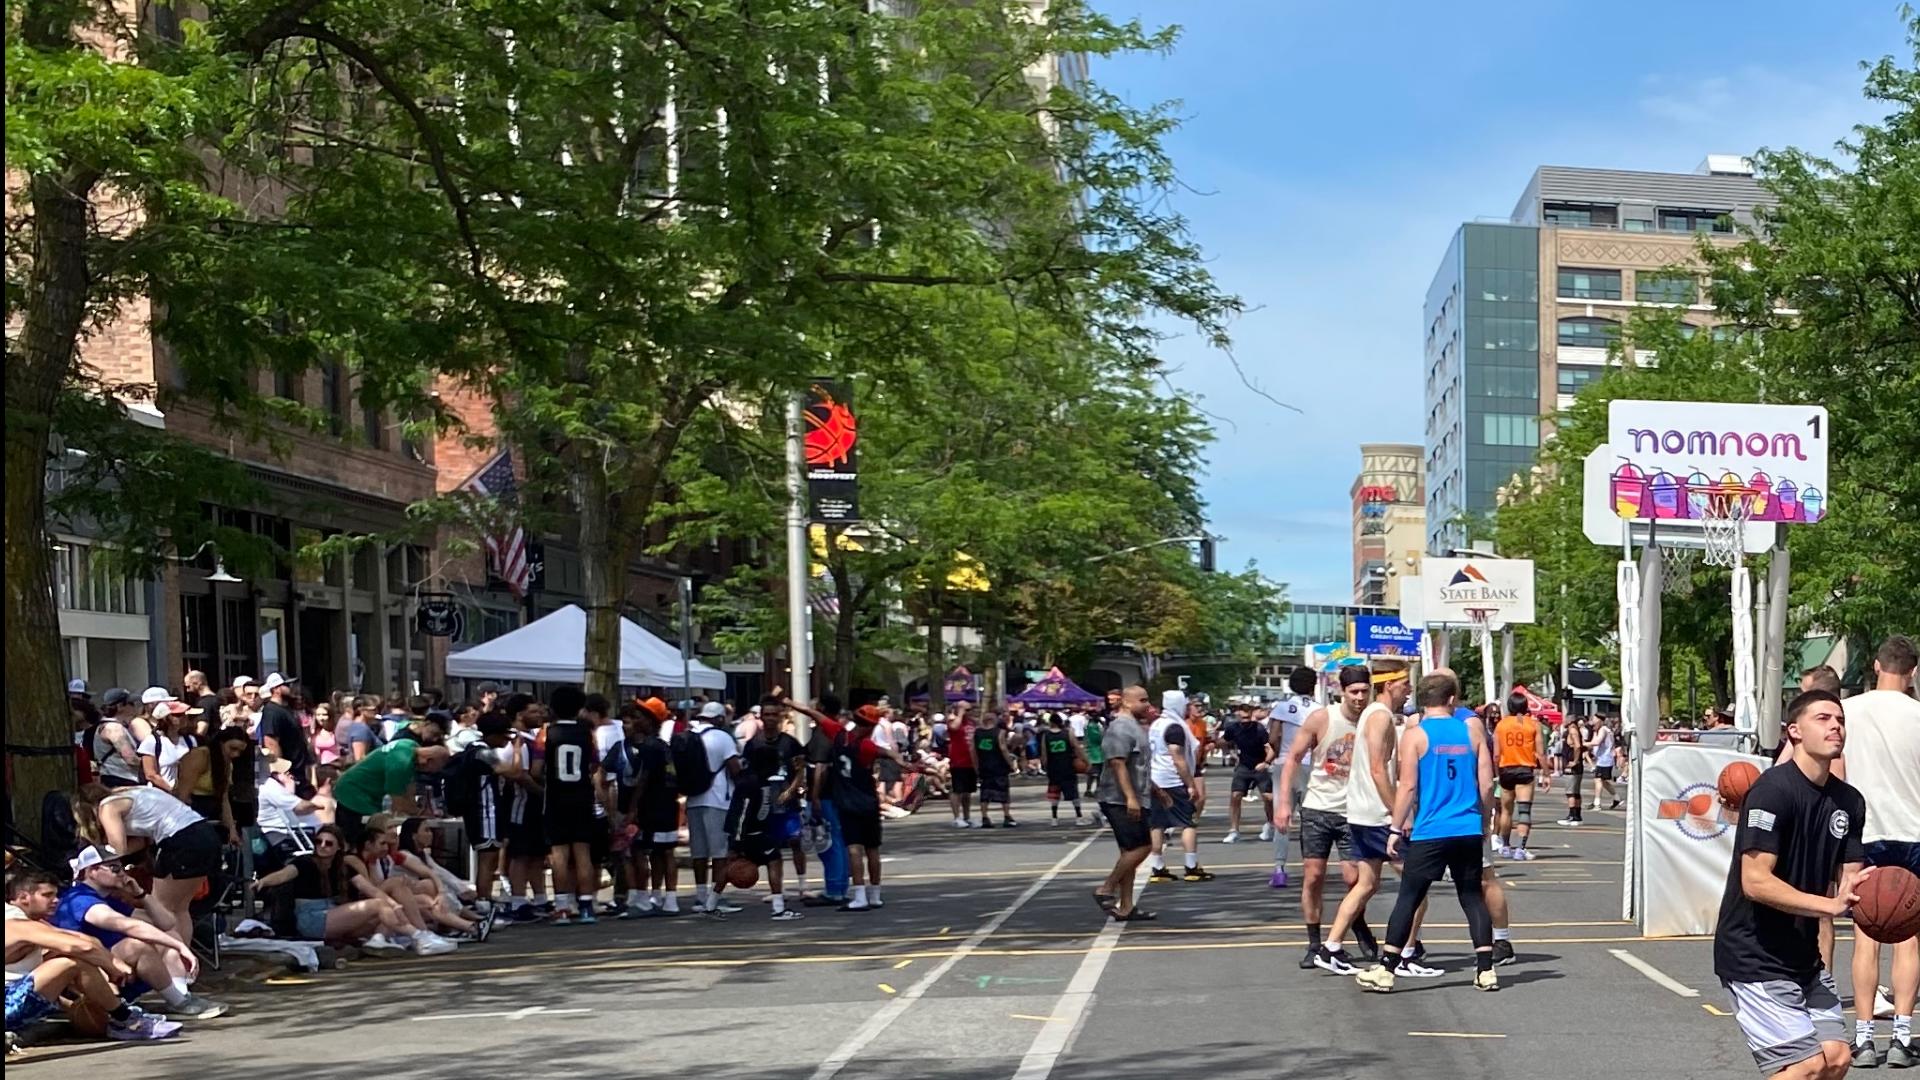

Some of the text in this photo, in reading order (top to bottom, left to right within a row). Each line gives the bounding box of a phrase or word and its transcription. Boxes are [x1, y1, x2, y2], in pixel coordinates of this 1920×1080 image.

[1806, 414, 1821, 439] 1
[1627, 428, 1807, 461] nomnom
[1440, 587, 1519, 600] STATE BANK
[1370, 625, 1414, 635] GLOBAL
[1506, 732, 1524, 747] 69
[558, 744, 582, 782] 0
[1447, 759, 1457, 780] 5
